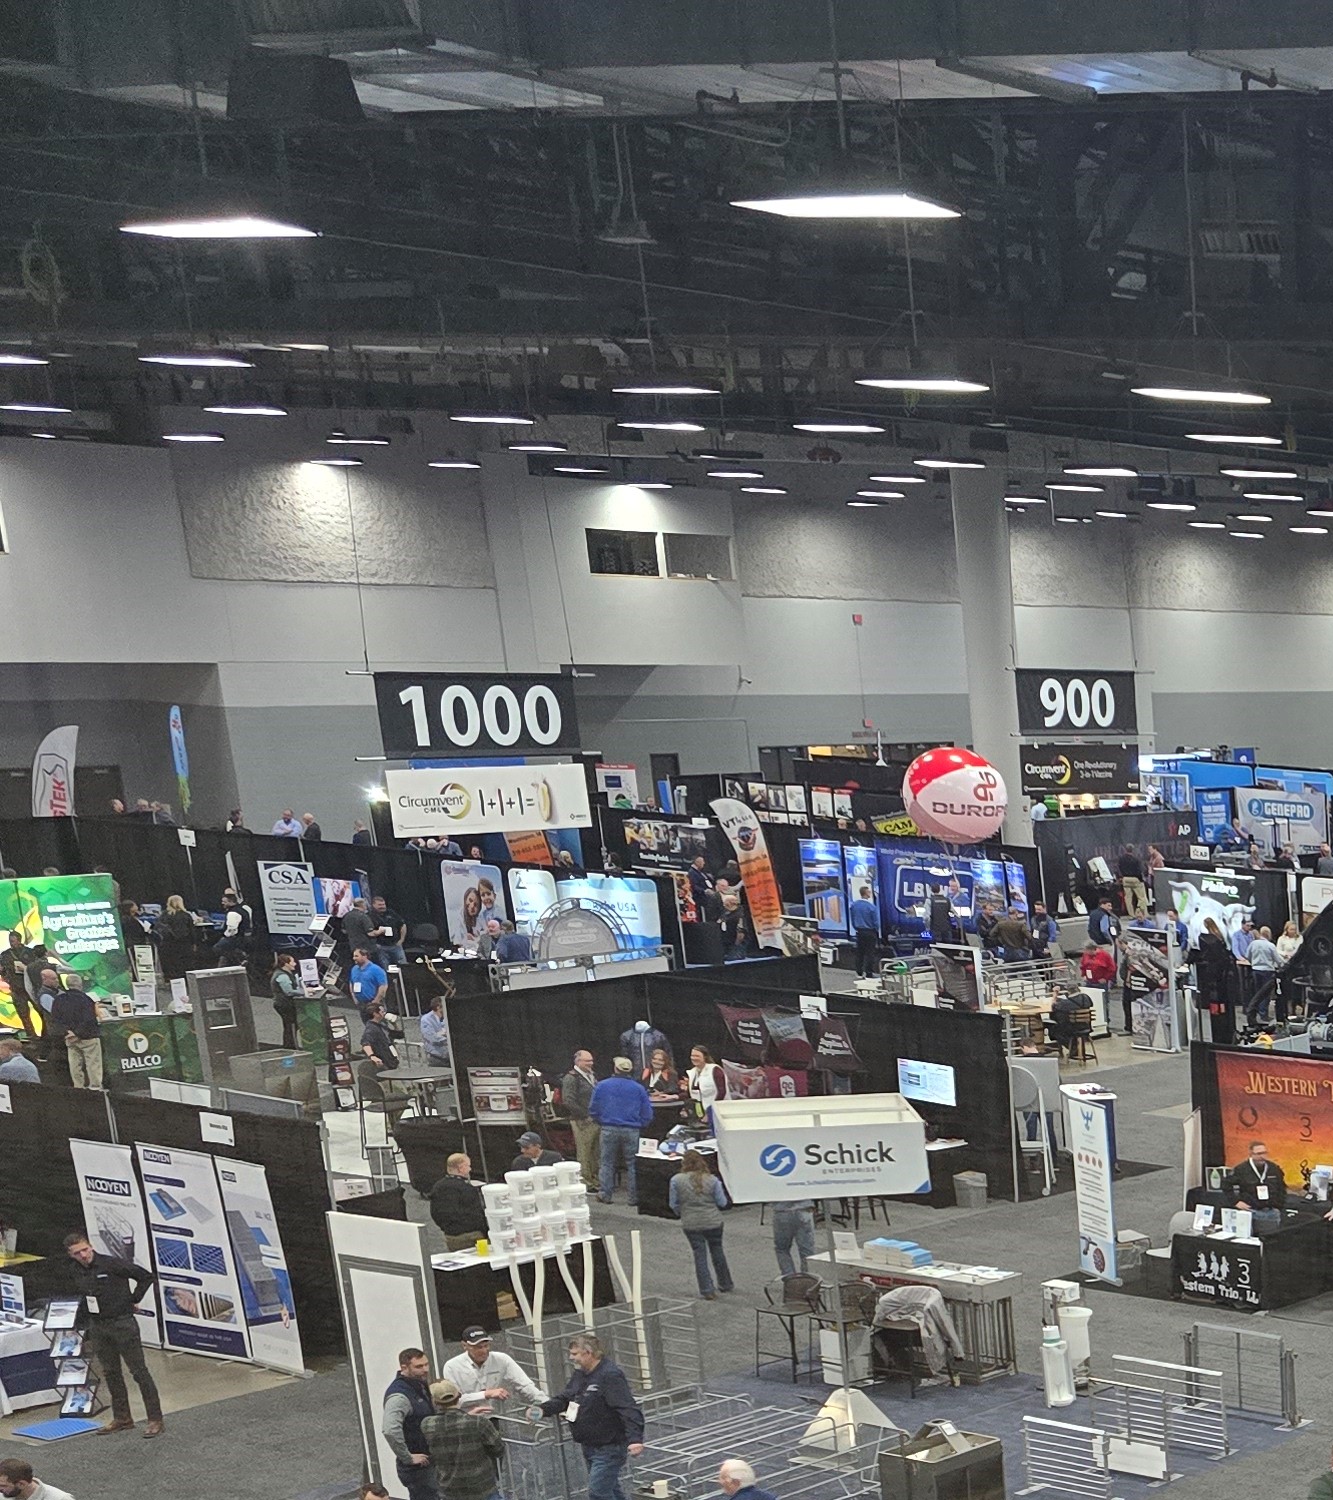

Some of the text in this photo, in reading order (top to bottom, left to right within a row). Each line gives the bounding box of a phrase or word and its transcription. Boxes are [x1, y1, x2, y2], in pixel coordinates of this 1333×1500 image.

[1039, 678, 1115, 728] 900
[399, 684, 562, 747] 1000
[1025, 763, 1065, 775] Circumvent
[399, 791, 464, 808] Circumvent
[1264, 801, 1310, 818] GENEPRO
[883, 820, 912, 833] CAM
[1177, 824, 1191, 836] AP
[268, 870, 308, 885] CSA
[1201, 879, 1238, 895] Phibro
[121, 1055, 161, 1070] RALCO
[1246, 1071, 1317, 1097] WESTERN
[144, 1152, 170, 1162] NOOYEN
[804, 1141, 895, 1167] Schick
[822, 1165, 882, 1175] ENTERPRISES
[87, 1178, 129, 1194] NOOYEN
